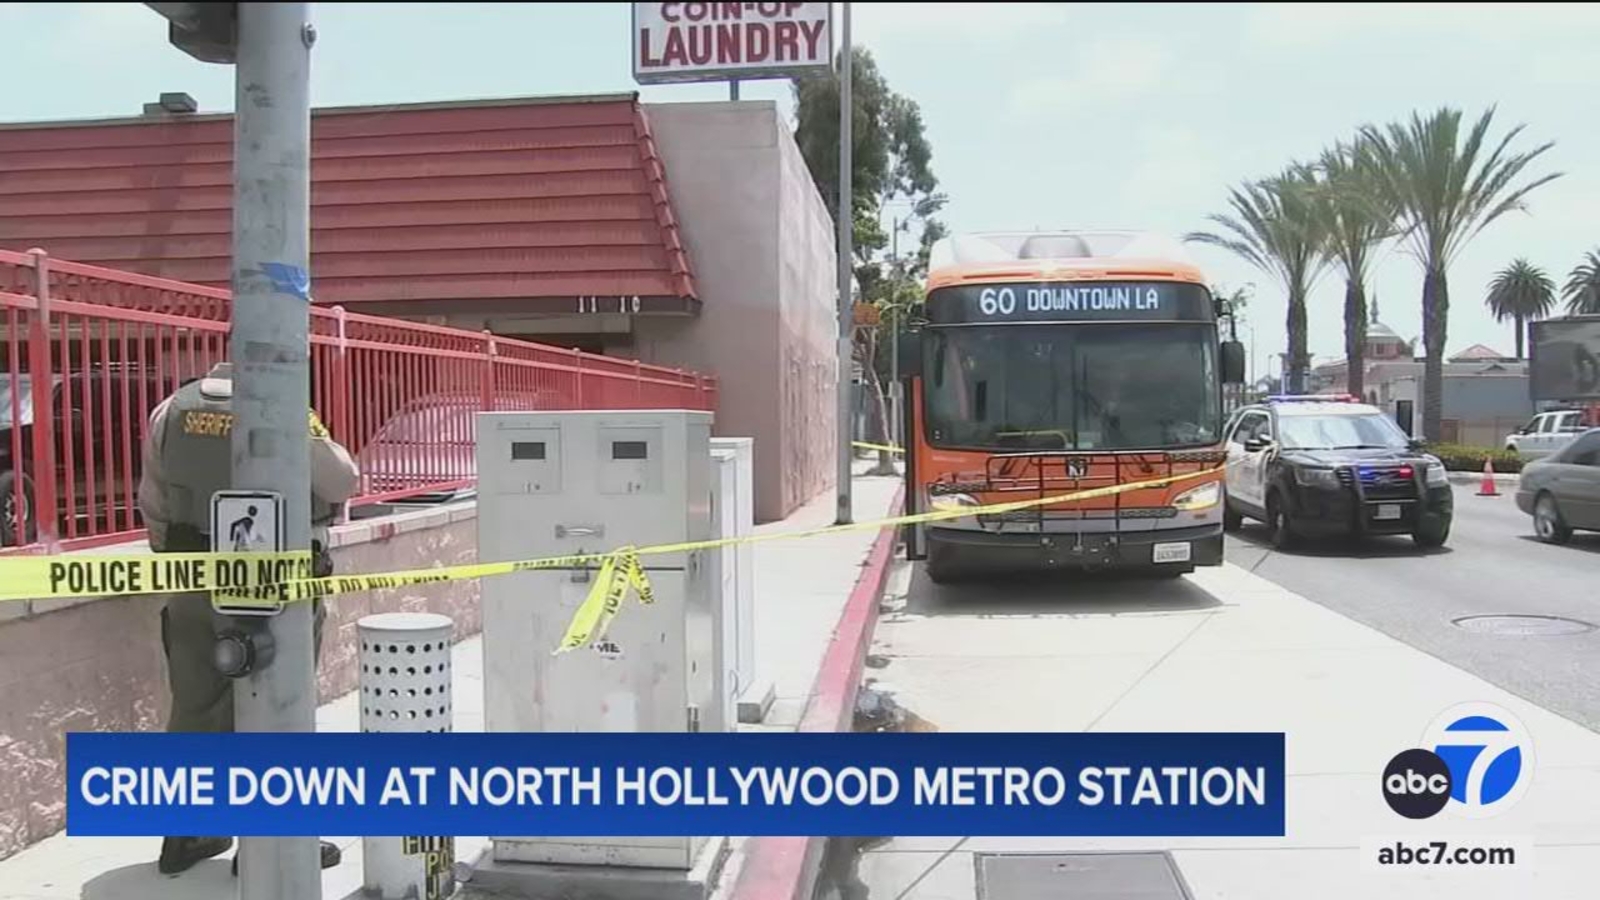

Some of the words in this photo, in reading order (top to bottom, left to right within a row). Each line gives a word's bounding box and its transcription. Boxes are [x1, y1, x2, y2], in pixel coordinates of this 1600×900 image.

[640, 20, 825, 67] LAUNDRY
[980, 288, 1015, 314] 60
[1027, 288, 1129, 311] DOWNTOWN
[1135, 288, 1159, 309] LA
[184, 412, 233, 436] SHERIFF
[50, 561, 142, 593] POLICE
[151, 560, 206, 591] LINE
[216, 558, 249, 588] DO
[257, 555, 294, 585] NOT
